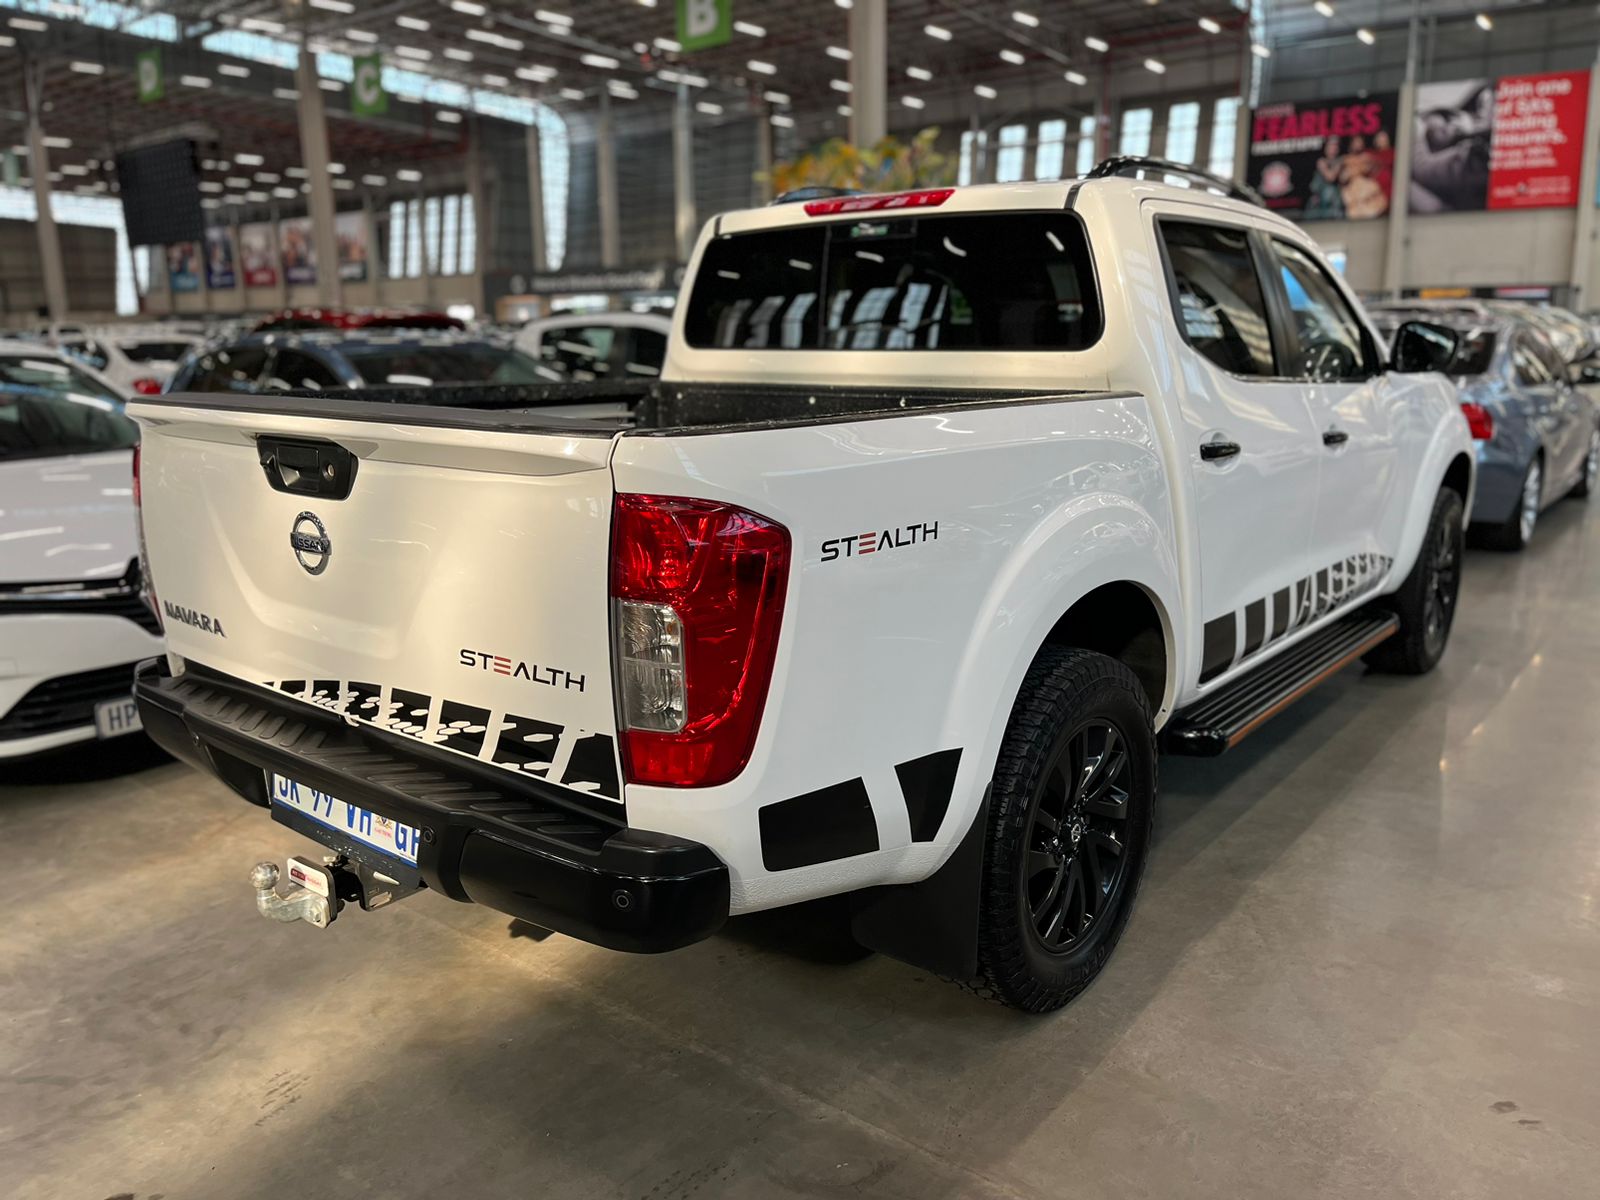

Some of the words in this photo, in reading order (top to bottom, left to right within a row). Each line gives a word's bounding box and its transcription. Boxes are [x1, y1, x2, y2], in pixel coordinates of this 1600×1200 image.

[686, 0, 719, 37] B
[355, 63, 378, 106] C
[1252, 104, 1381, 142] FEARLESS
[821, 521, 938, 562] STEALTH
[164, 600, 226, 638] NAVARA
[460, 649, 585, 692] STEALTH
